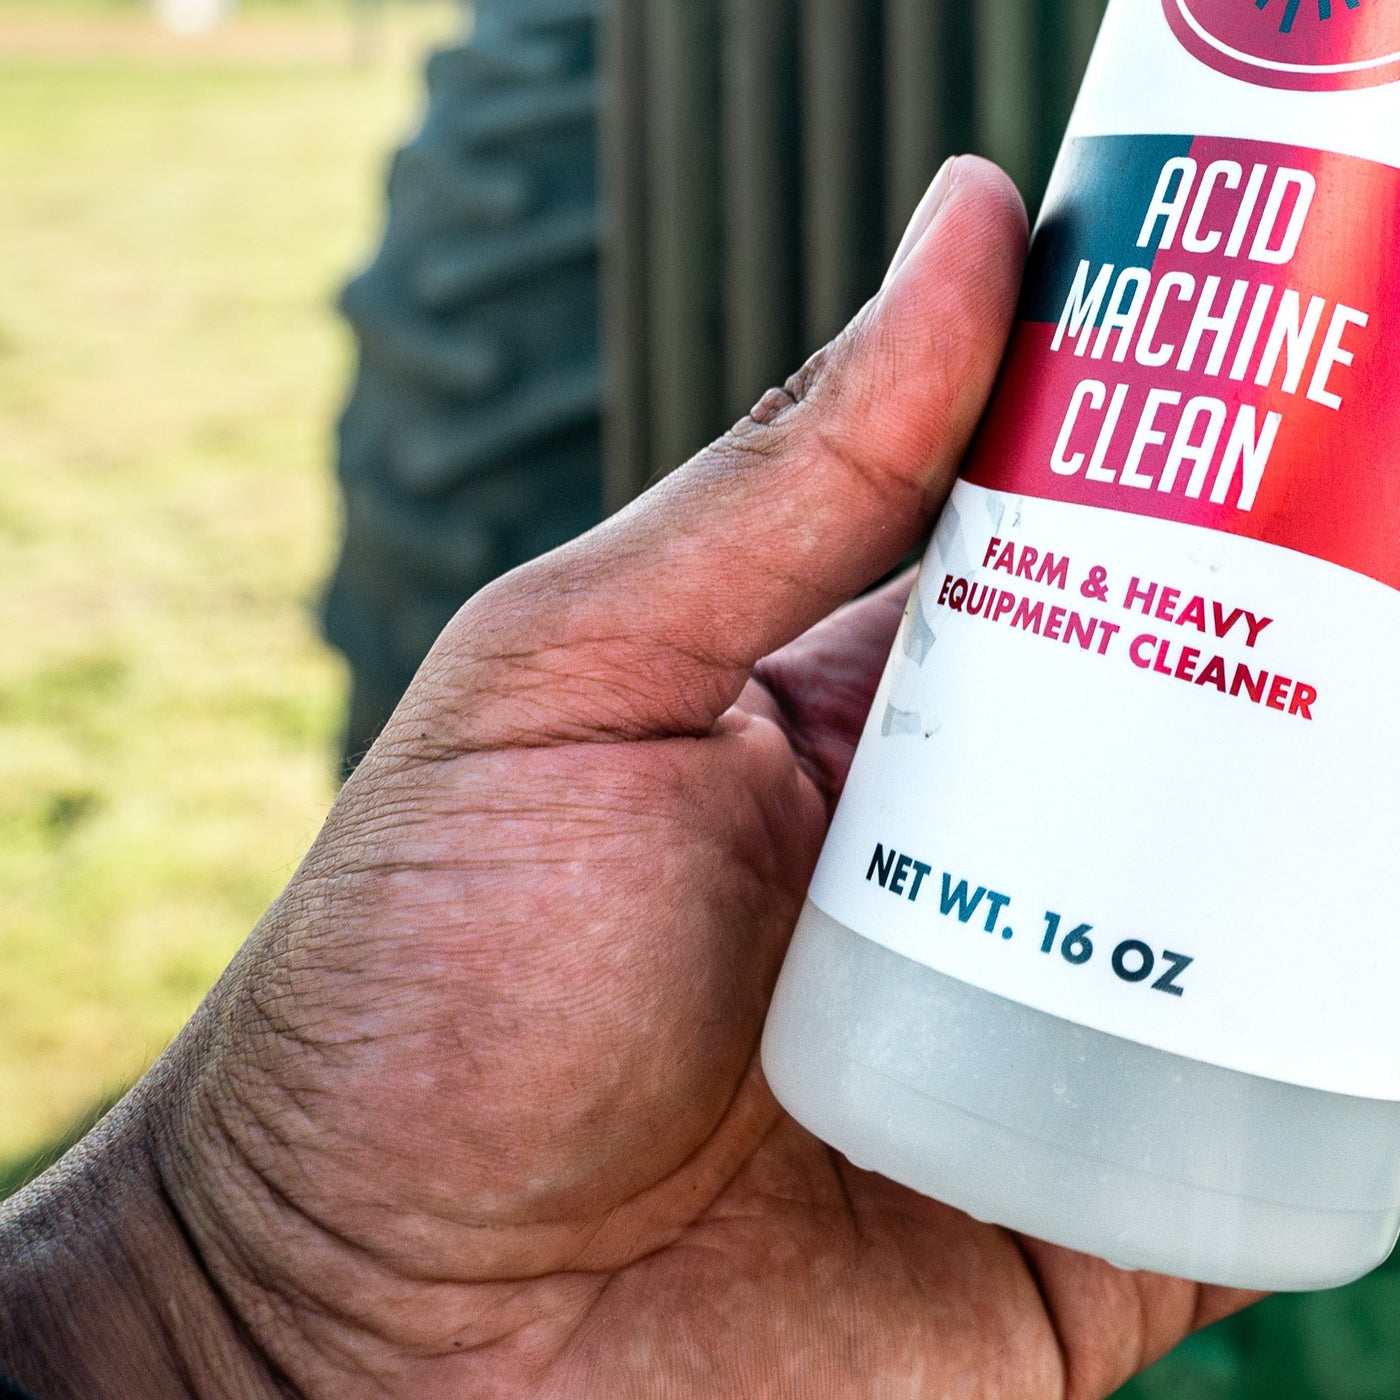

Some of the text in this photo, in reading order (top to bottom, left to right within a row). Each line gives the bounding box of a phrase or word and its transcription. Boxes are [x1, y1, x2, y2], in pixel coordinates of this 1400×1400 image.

[1137, 156, 1316, 264] ACID
[1050, 260, 1369, 410] MACHINE
[1050, 379, 1282, 511] CLEAN
[937, 574, 1317, 720] EQUIPMENT CLEANER
[982, 537, 1274, 648] FARM & HEAVY
[866, 843, 1195, 996] NET WT. 16 OZ
